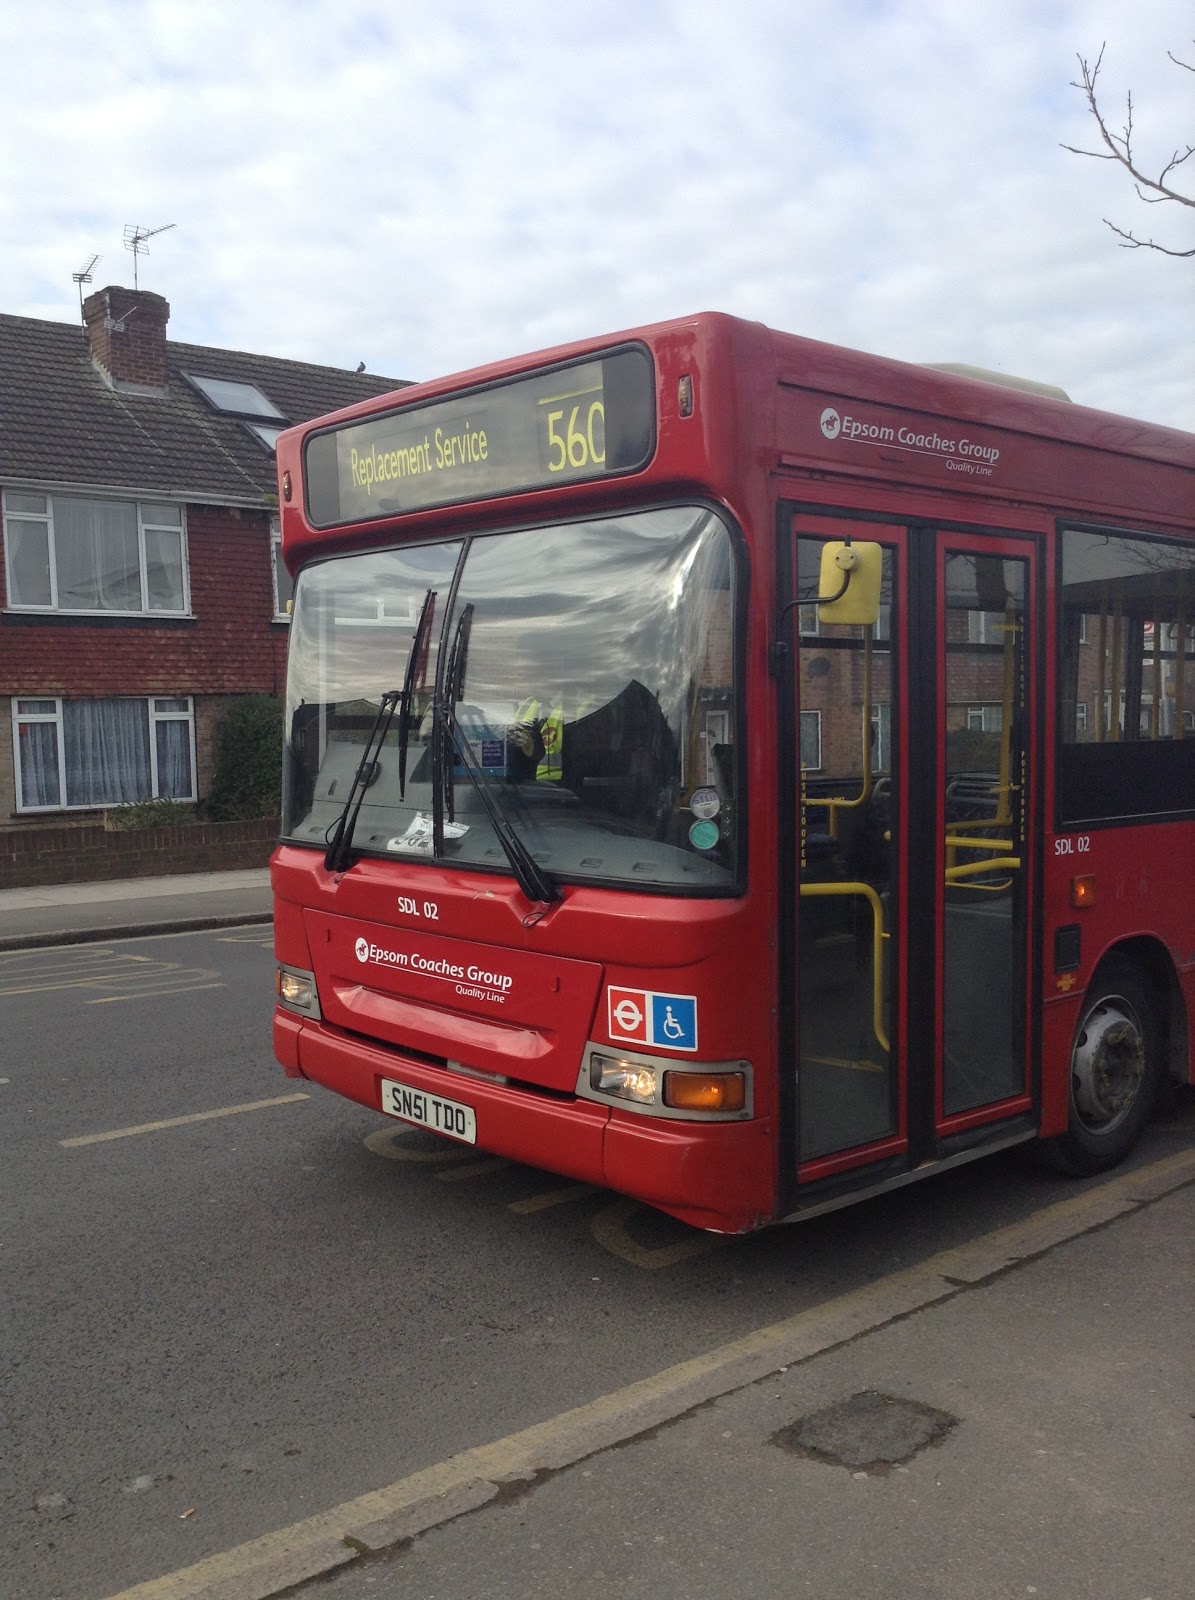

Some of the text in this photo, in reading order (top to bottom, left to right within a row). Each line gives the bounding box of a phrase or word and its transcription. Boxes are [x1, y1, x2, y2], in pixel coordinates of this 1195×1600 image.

[351, 421, 488, 495] Replacement Service
[548, 401, 606, 472] 560
[842, 416, 1000, 463] Epsom Coaches Group
[946, 459, 993, 477] Quality Line
[1054, 836, 1090, 855] SDL 02
[397, 896, 439, 920] SDL 02
[369, 944, 513, 991] Epsom Coaches Group
[455, 984, 505, 1004] Quality Line
[392, 1087, 466, 1135] SN51 TDO
